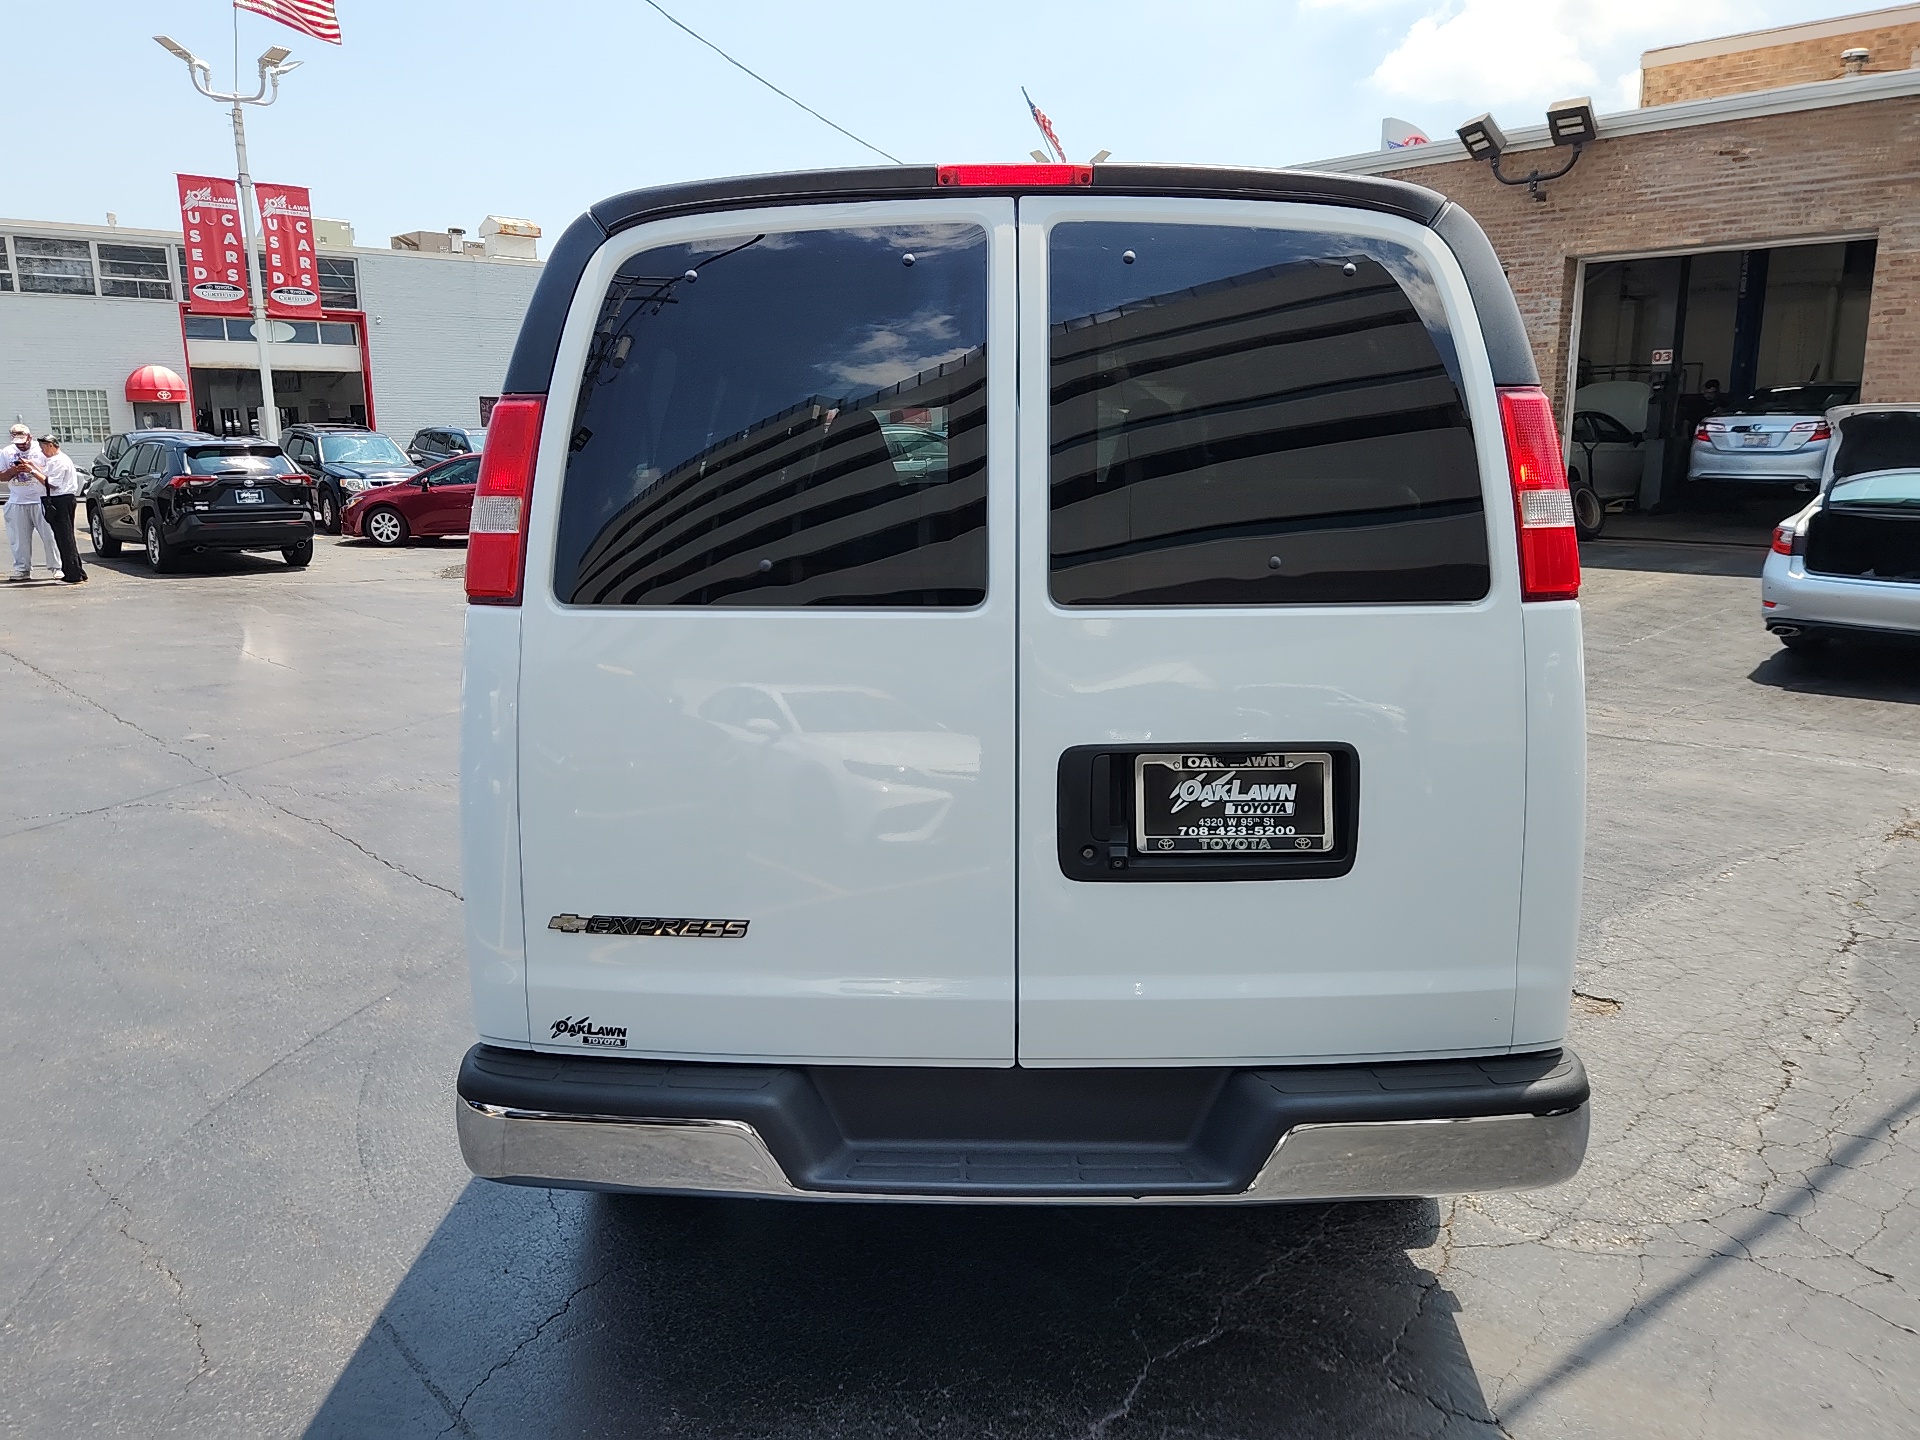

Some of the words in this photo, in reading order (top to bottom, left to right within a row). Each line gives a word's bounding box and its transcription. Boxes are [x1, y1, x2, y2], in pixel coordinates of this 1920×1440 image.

[190, 190, 212, 201] OAK
[288, 204, 309, 212] LAWN
[187, 211, 207, 280] USED
[221, 214, 239, 282] CARS
[267, 218, 285, 284] USED
[295, 221, 312, 287] CARS
[1653, 351, 1671, 361] 03
[1187, 757, 1225, 768] OAK
[1232, 803, 1288, 814] TOYOTA
[1198, 818, 1223, 826] 4320
[1227, 818, 1237, 826] W
[1240, 817, 1260, 826] 95th
[1263, 818, 1275, 826] St
[1178, 826, 1296, 836] 708-423-5200
[1198, 838, 1271, 850] TOYOTA
[591, 916, 749, 938] EXPRESS
[587, 1037, 621, 1046] TOYOTA
